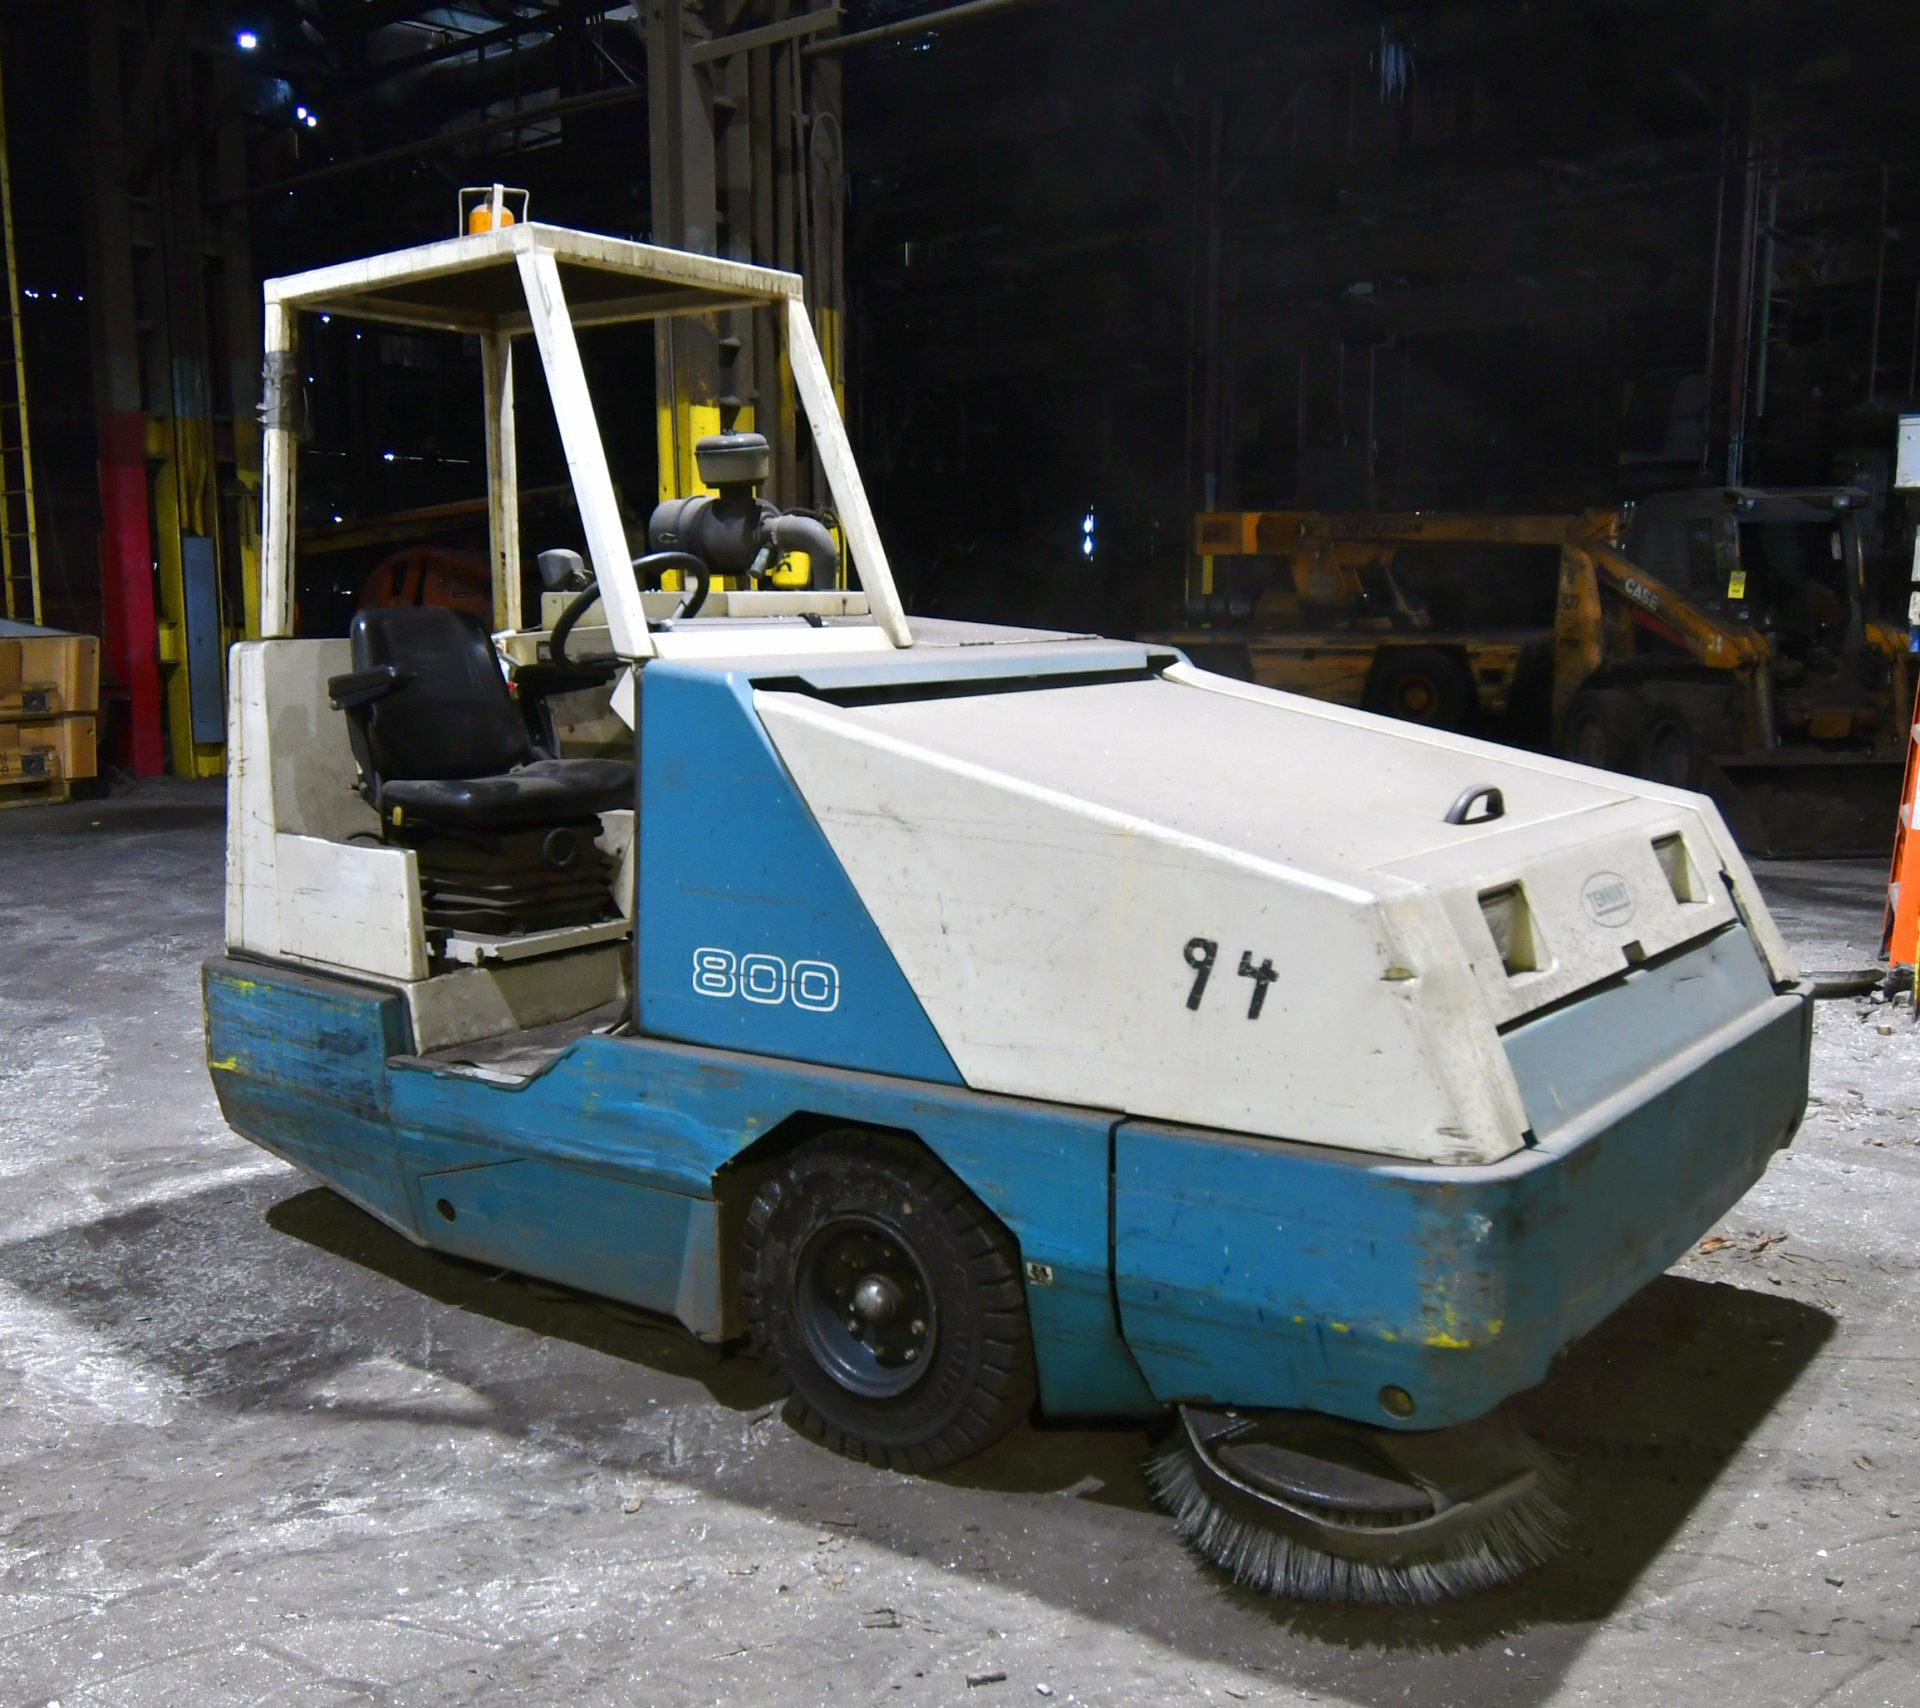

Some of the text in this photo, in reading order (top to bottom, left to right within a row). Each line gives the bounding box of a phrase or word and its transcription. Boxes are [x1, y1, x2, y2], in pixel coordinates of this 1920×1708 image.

[1624, 577, 1659, 612] CASE
[692, 946, 840, 1013] 800
[1183, 937, 1280, 1020] 94
